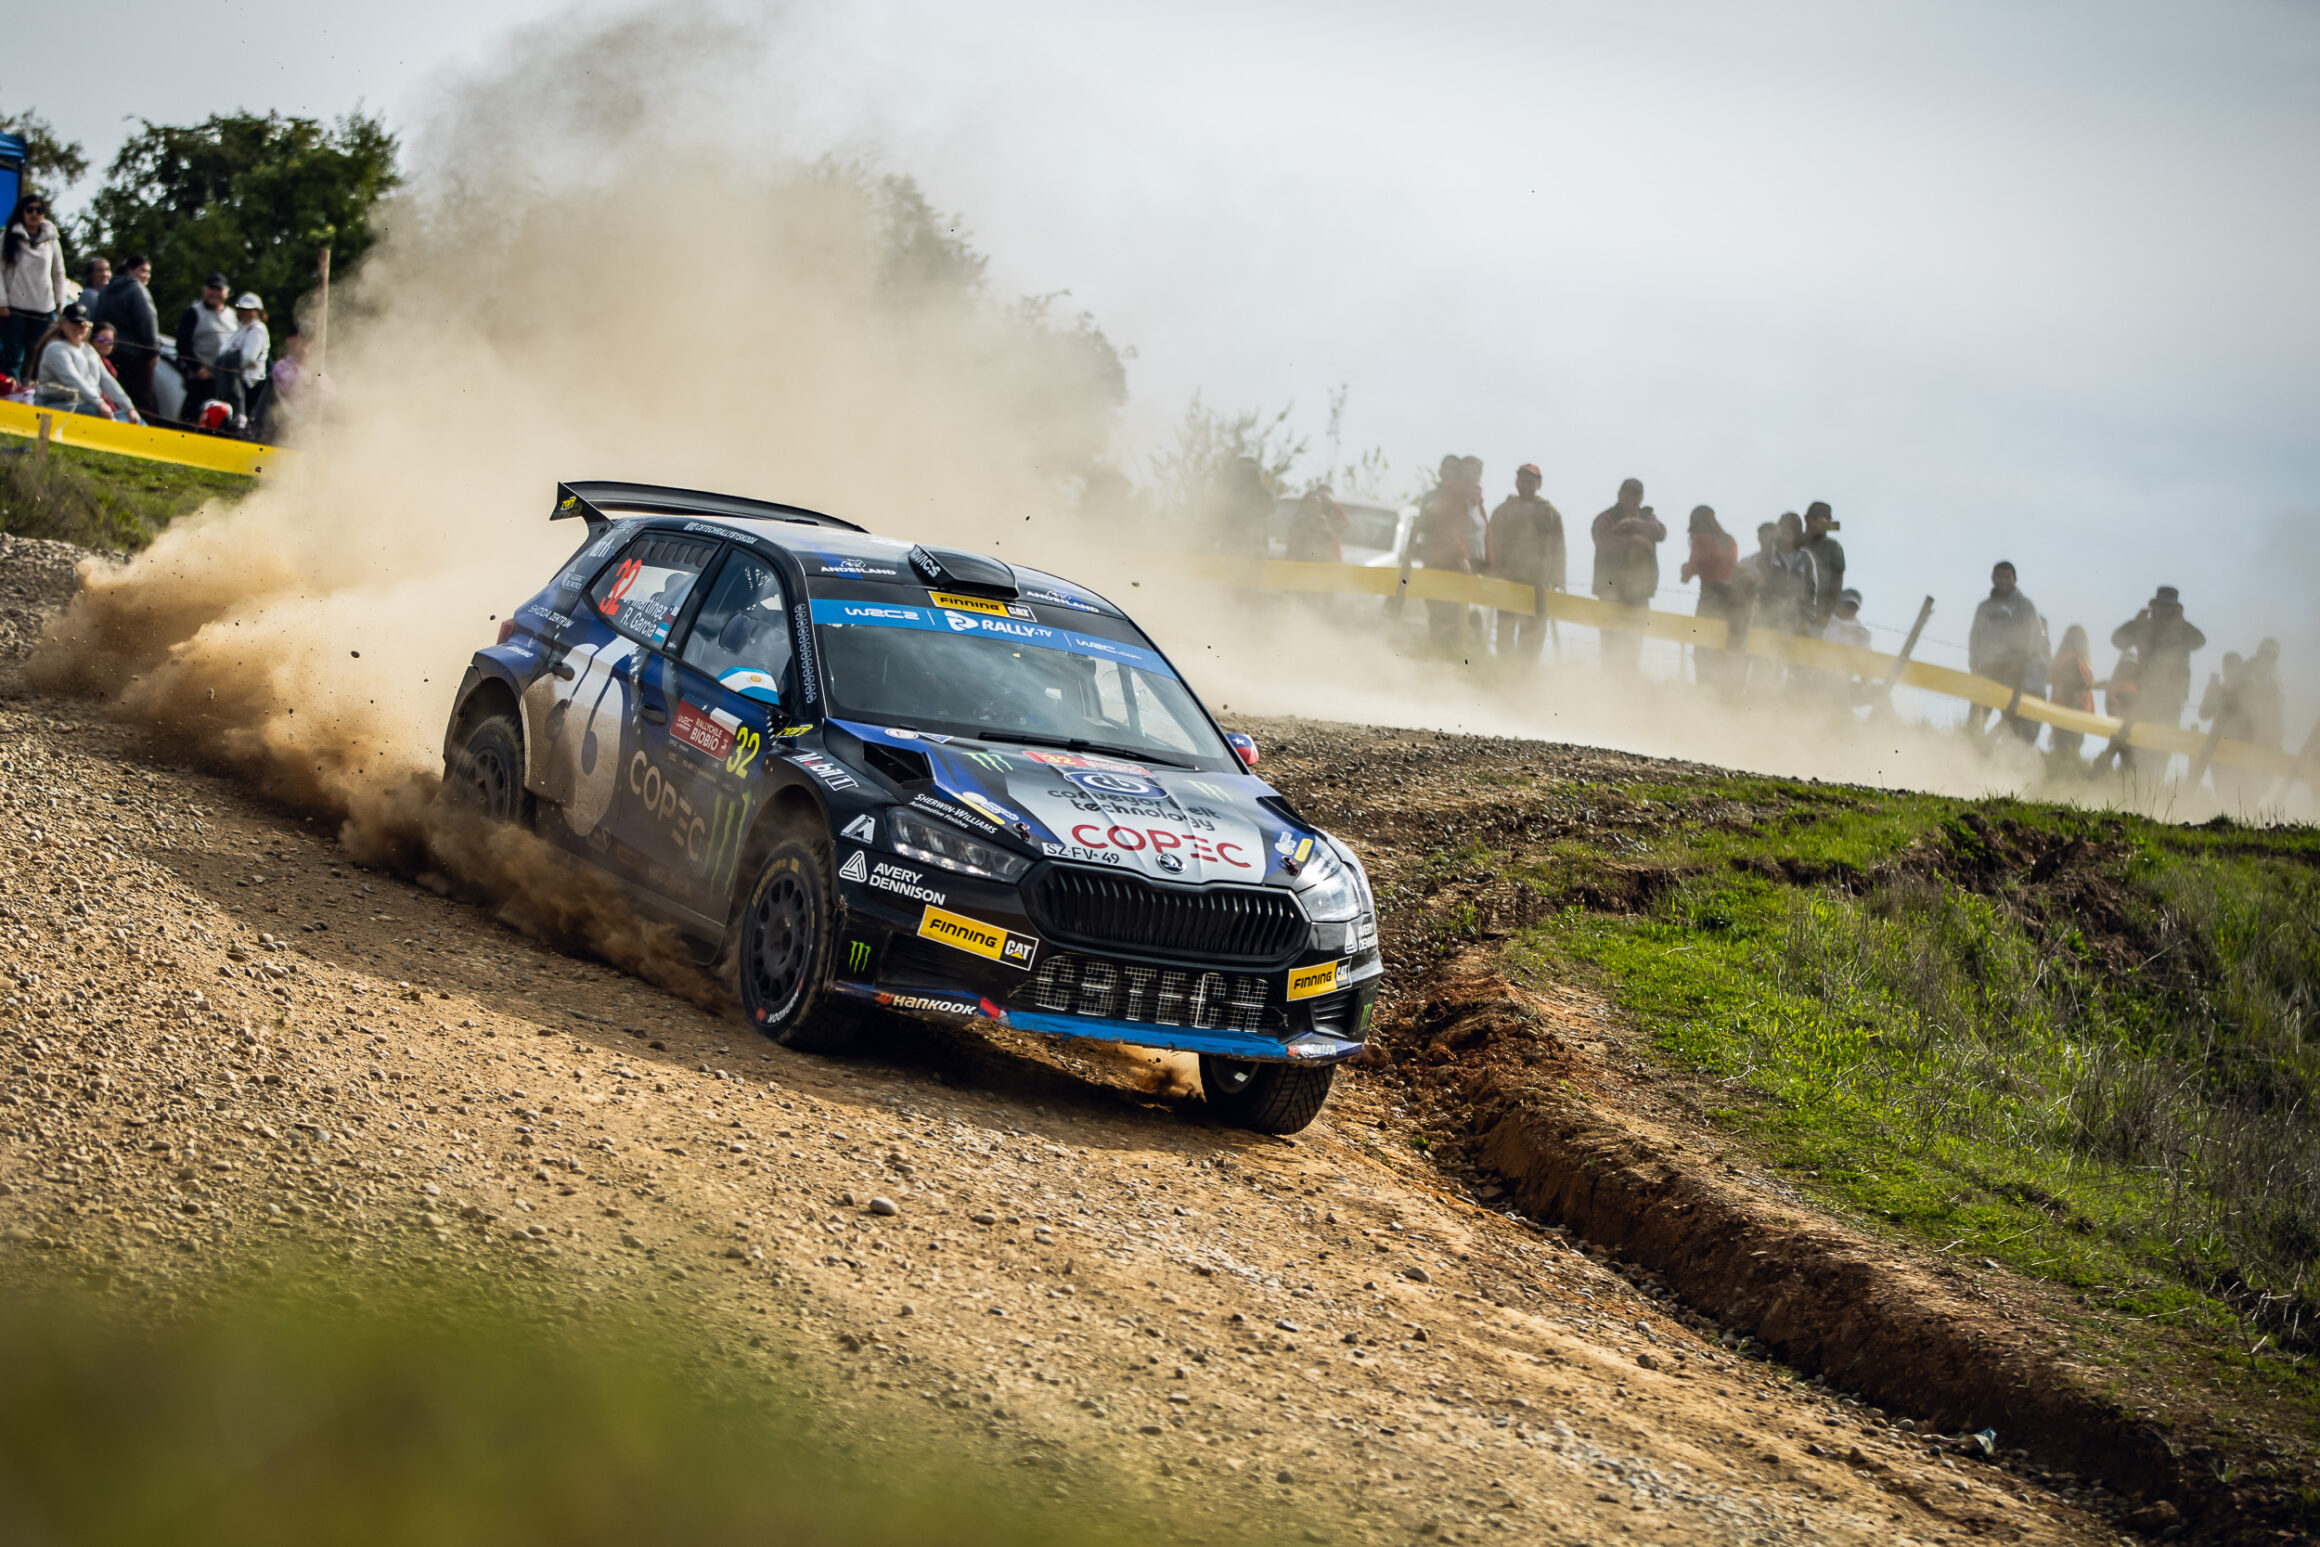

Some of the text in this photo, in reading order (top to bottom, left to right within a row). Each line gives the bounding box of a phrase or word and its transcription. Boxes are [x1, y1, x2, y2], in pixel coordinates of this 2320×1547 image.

[598, 558, 642, 616] 32
[844, 607, 920, 621] WRC2
[939, 597, 1000, 612] FINNING
[725, 726, 760, 779] 32
[791, 752, 846, 778] Mobil
[914, 793, 998, 834] SHERWIN-WILLIAMS
[1070, 799, 1216, 832] technology
[1071, 824, 1252, 868] COPEC
[873, 862, 923, 885] AVERY
[869, 874, 946, 906] DENNISON
[929, 918, 1034, 960] FINNING CAT
[1293, 964, 1349, 990] FINNING CAT
